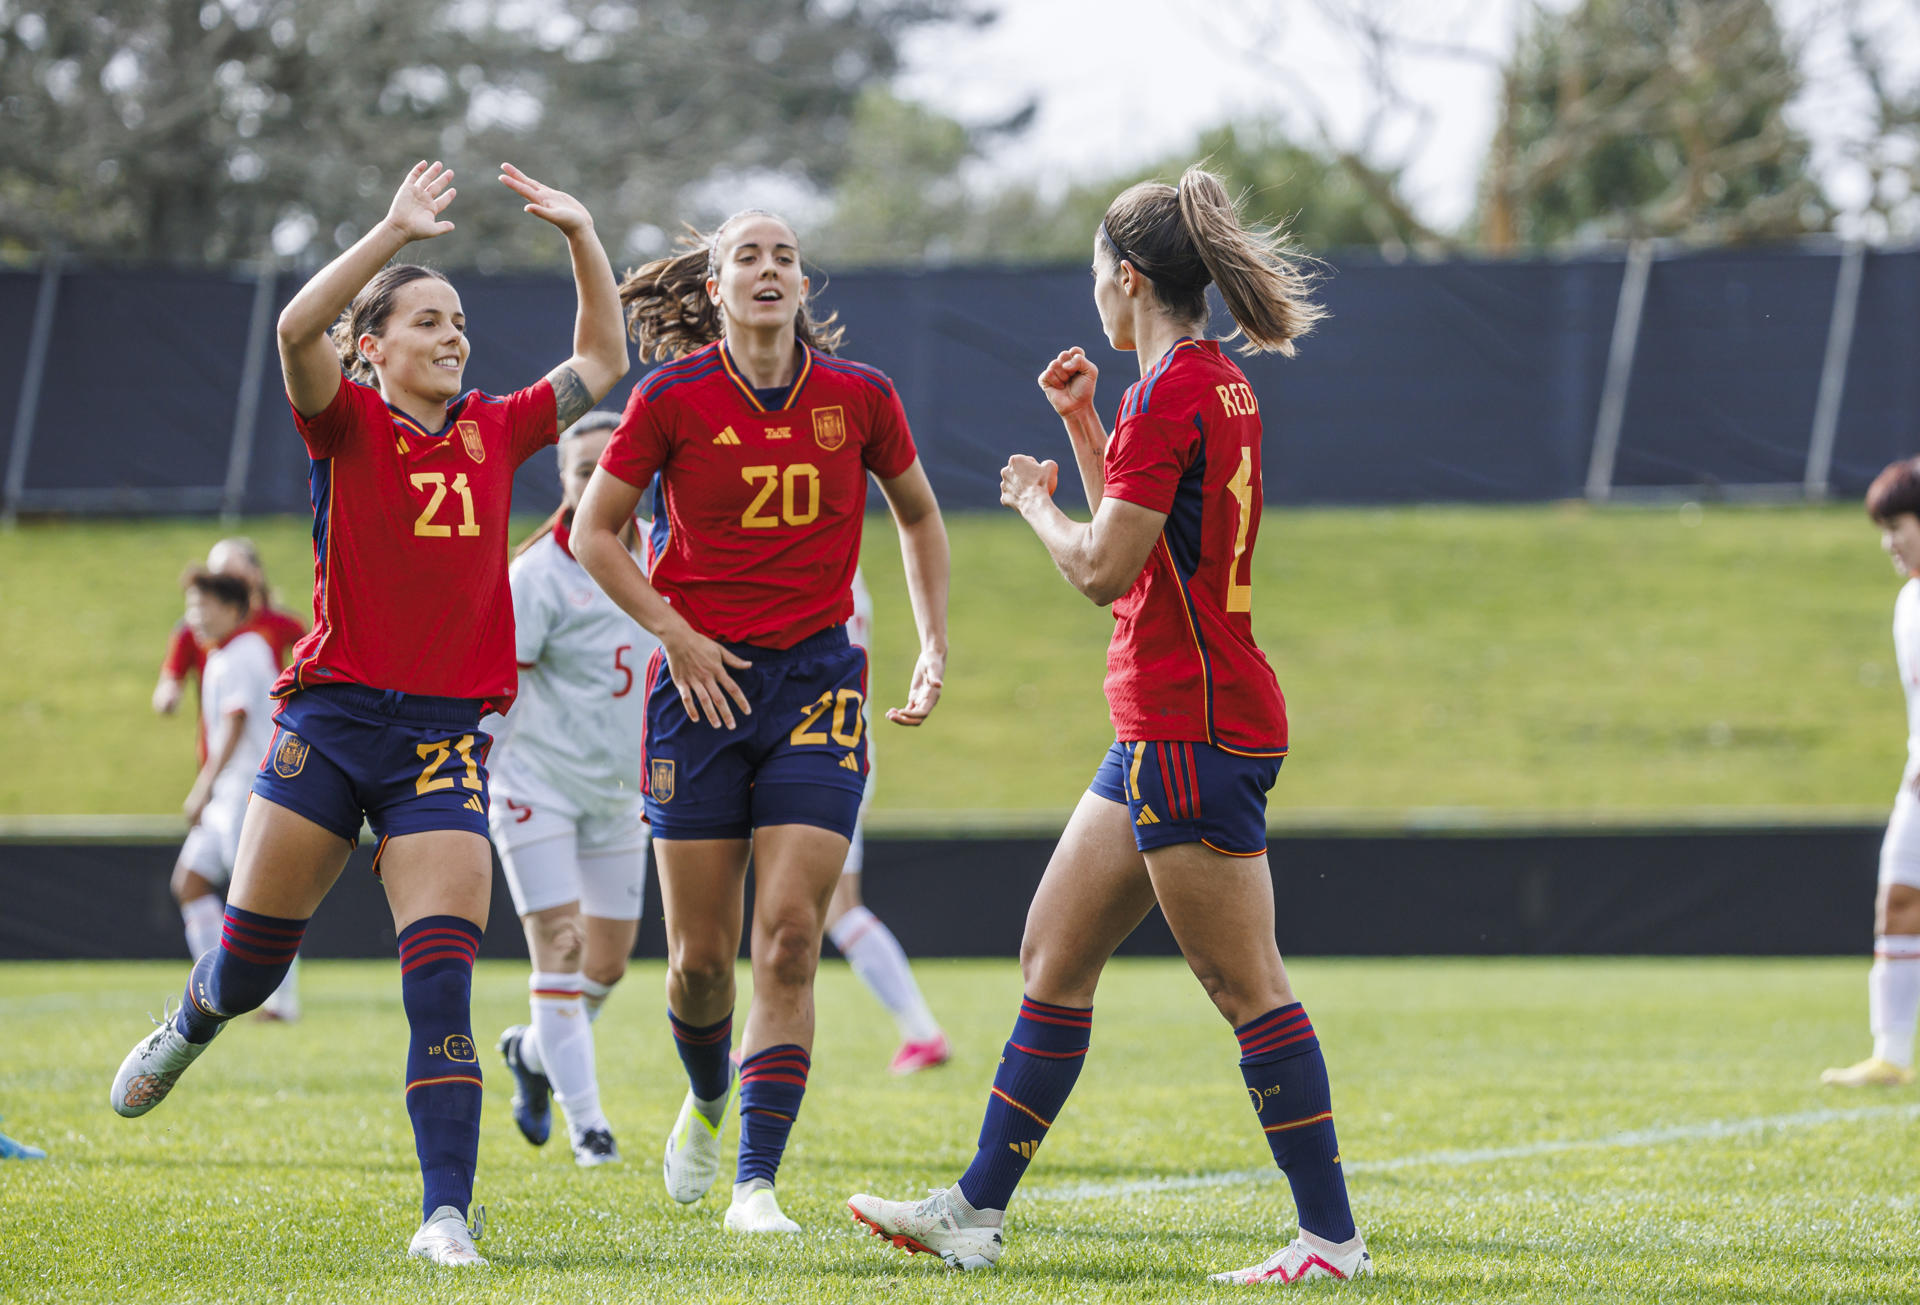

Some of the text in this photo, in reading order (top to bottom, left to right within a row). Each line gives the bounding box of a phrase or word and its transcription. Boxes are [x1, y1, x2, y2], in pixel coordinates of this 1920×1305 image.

[1215, 383, 1258, 418] RED
[410, 472, 480, 537] 21
[741, 463, 820, 528] 20
[1226, 446, 1252, 613] 1
[612, 645, 634, 699] 5
[790, 688, 864, 748] 20
[415, 734, 483, 796] 21
[506, 797, 533, 824] 5
[427, 1045, 442, 1056] 19
